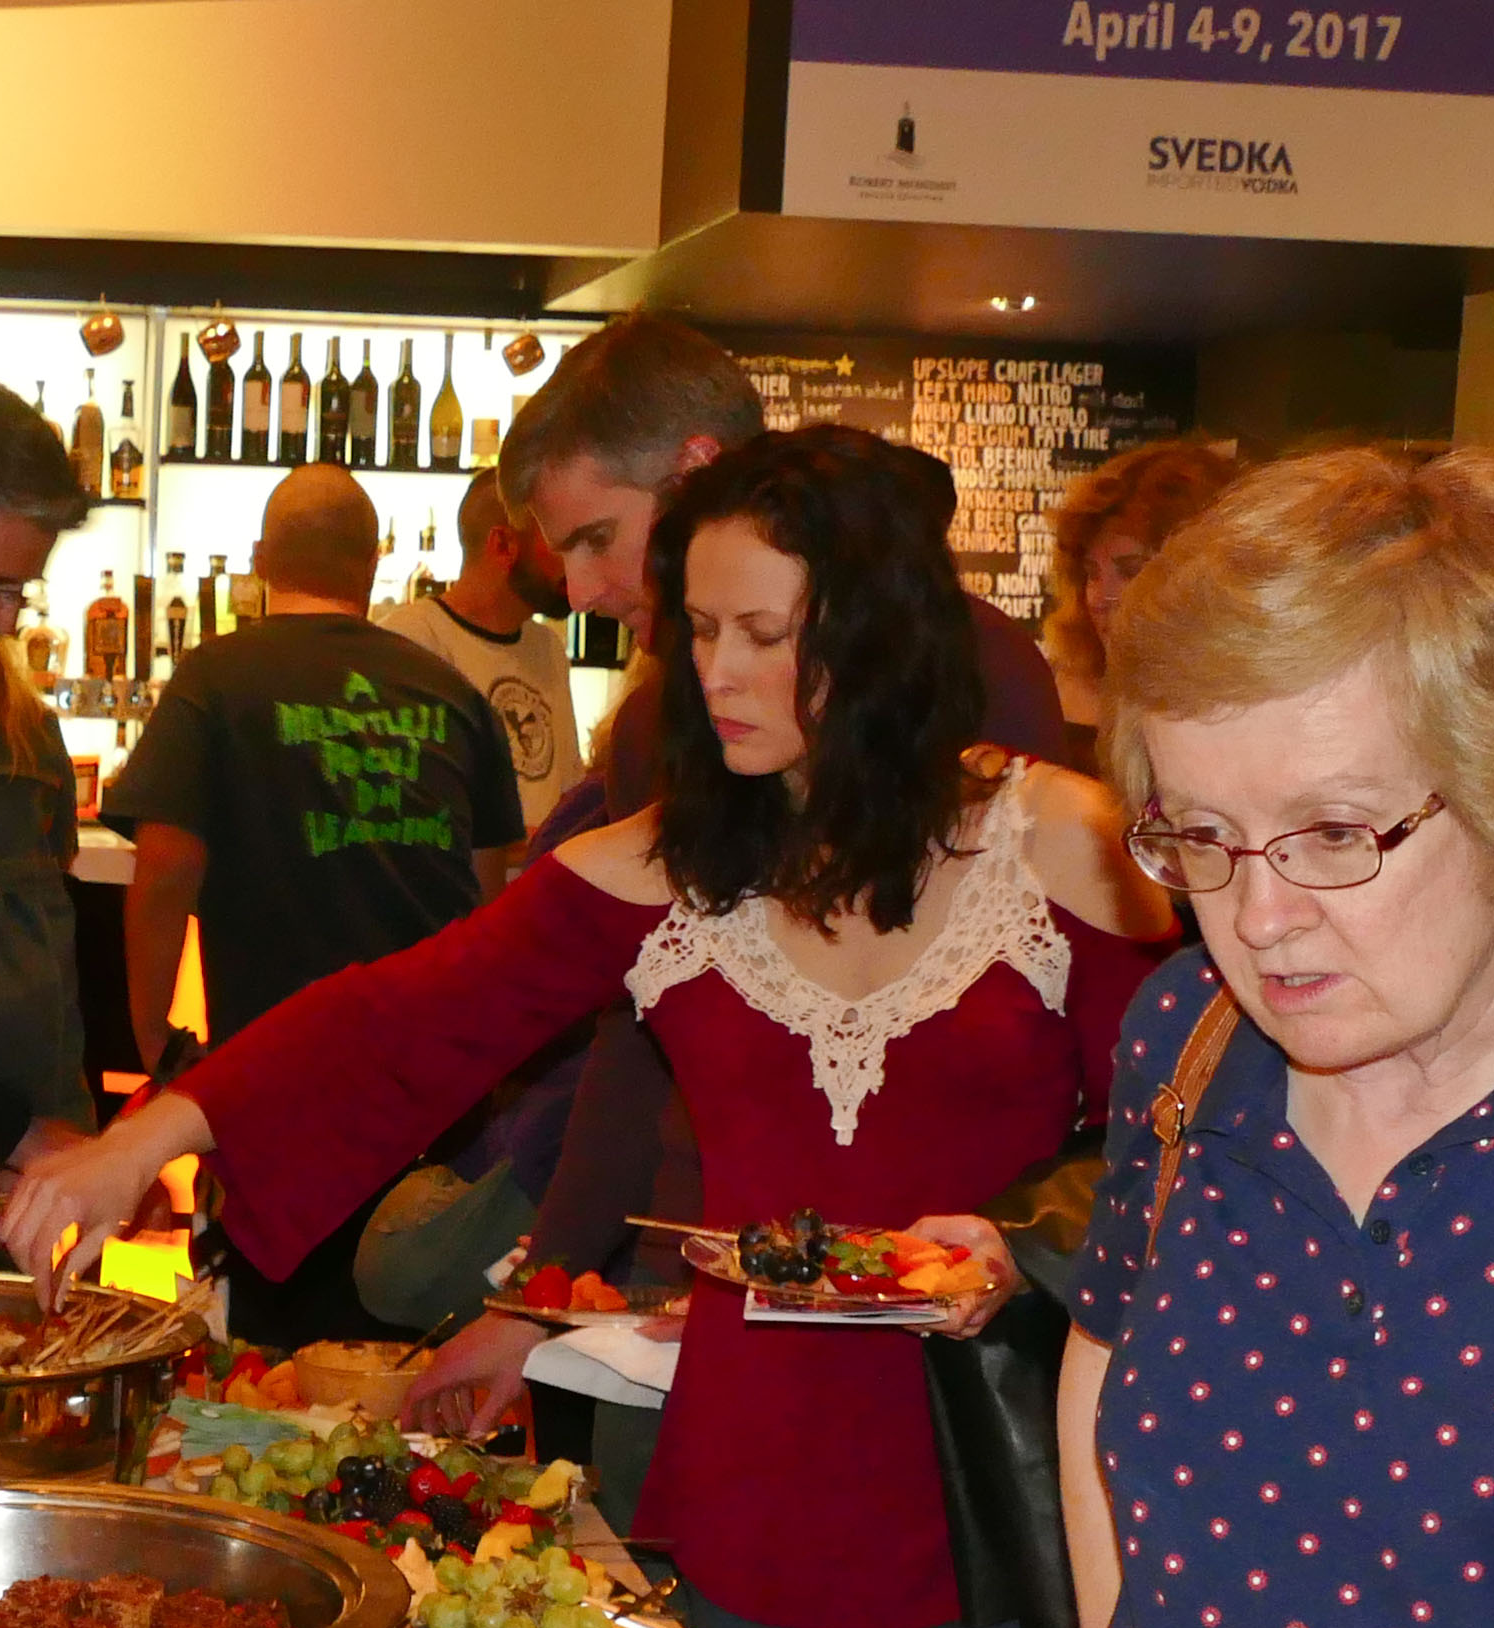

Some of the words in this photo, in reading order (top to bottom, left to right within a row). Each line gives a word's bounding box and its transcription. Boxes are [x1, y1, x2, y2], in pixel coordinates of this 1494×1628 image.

[1062, 1, 1175, 61] April
[1187, 6, 1273, 62] 4-9,
[1286, 10, 1402, 61] 2017
[1148, 136, 1292, 176] SVEDKA
[1240, 178, 1298, 194] VODKA
[913, 357, 989, 380] UPSLOPE
[994, 359, 1049, 382] CRAFT
[1051, 362, 1103, 386] LAGER
[913, 379, 959, 403] LEFT
[962, 381, 1012, 403] HAND
[1017, 382, 1072, 406] NITRO
[911, 401, 962, 423] AVERY
[910, 422, 950, 445] NEW
[954, 423, 1029, 447] BELGIUM
[1034, 426, 1066, 449] FAT
[1071, 428, 1110, 450] TIRE
[983, 447, 1052, 470] BEEHIVE
[973, 509, 1016, 532] BEER
[344, 670, 378, 703] A
